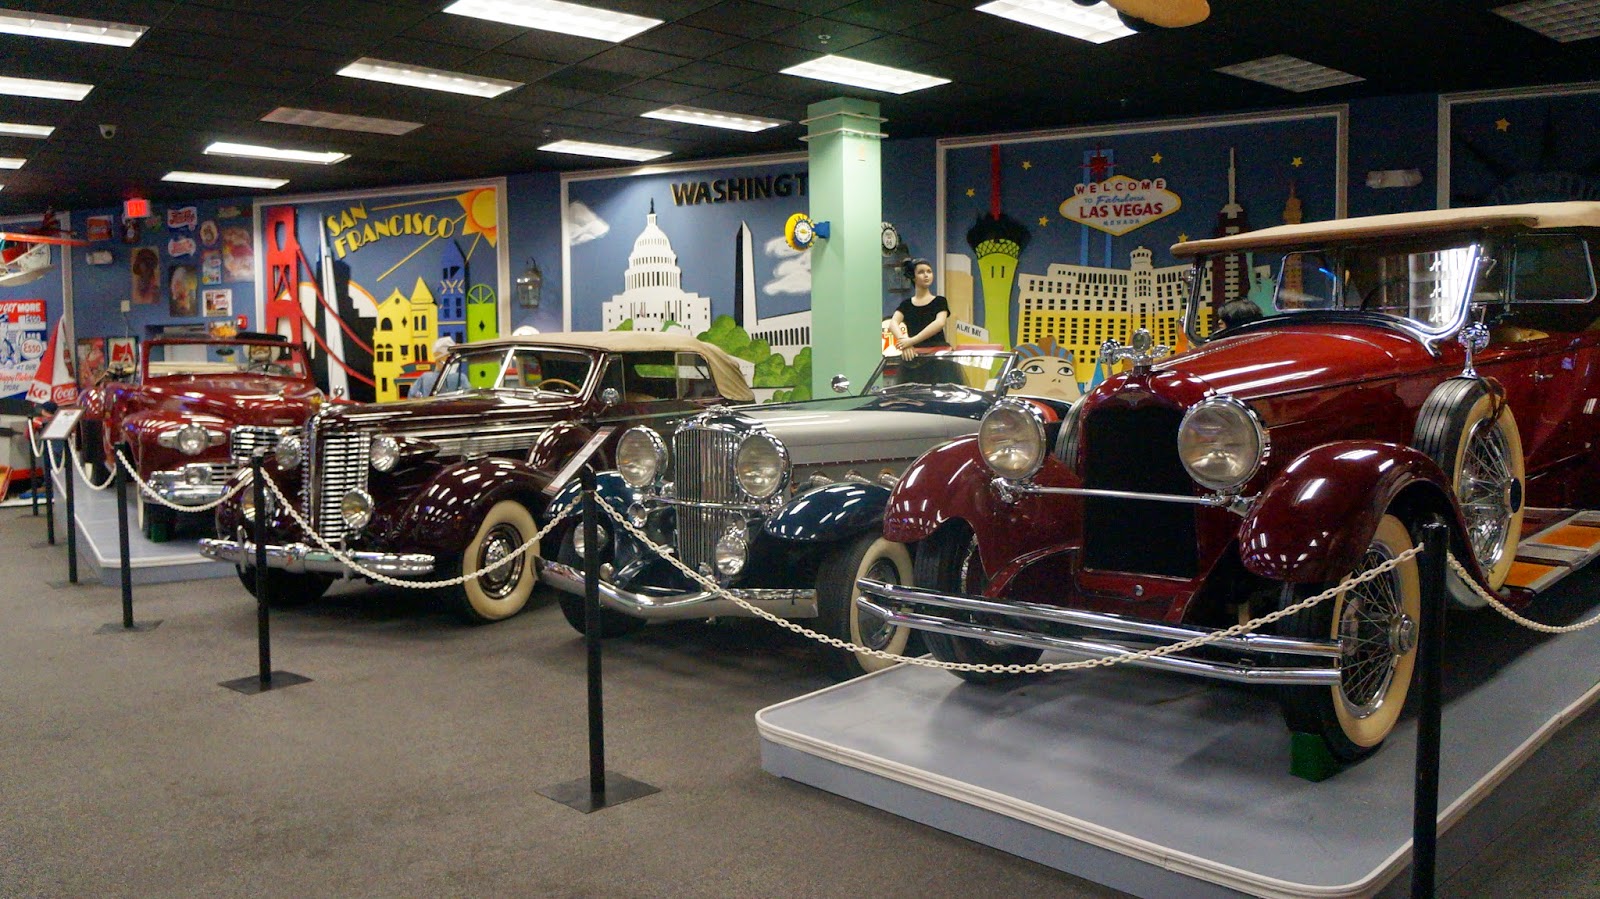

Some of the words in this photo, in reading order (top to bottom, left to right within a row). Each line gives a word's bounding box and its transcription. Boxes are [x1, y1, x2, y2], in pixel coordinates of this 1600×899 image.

[1075, 180, 1163, 195] WELCOME
[1080, 205, 1109, 219] LAS
[1113, 202, 1163, 217] VEGAS
[327, 201, 368, 237] SAN
[334, 212, 455, 259] FRANCISCO
[17, 302, 41, 313] MORE
[971, 327, 982, 337] BAY
